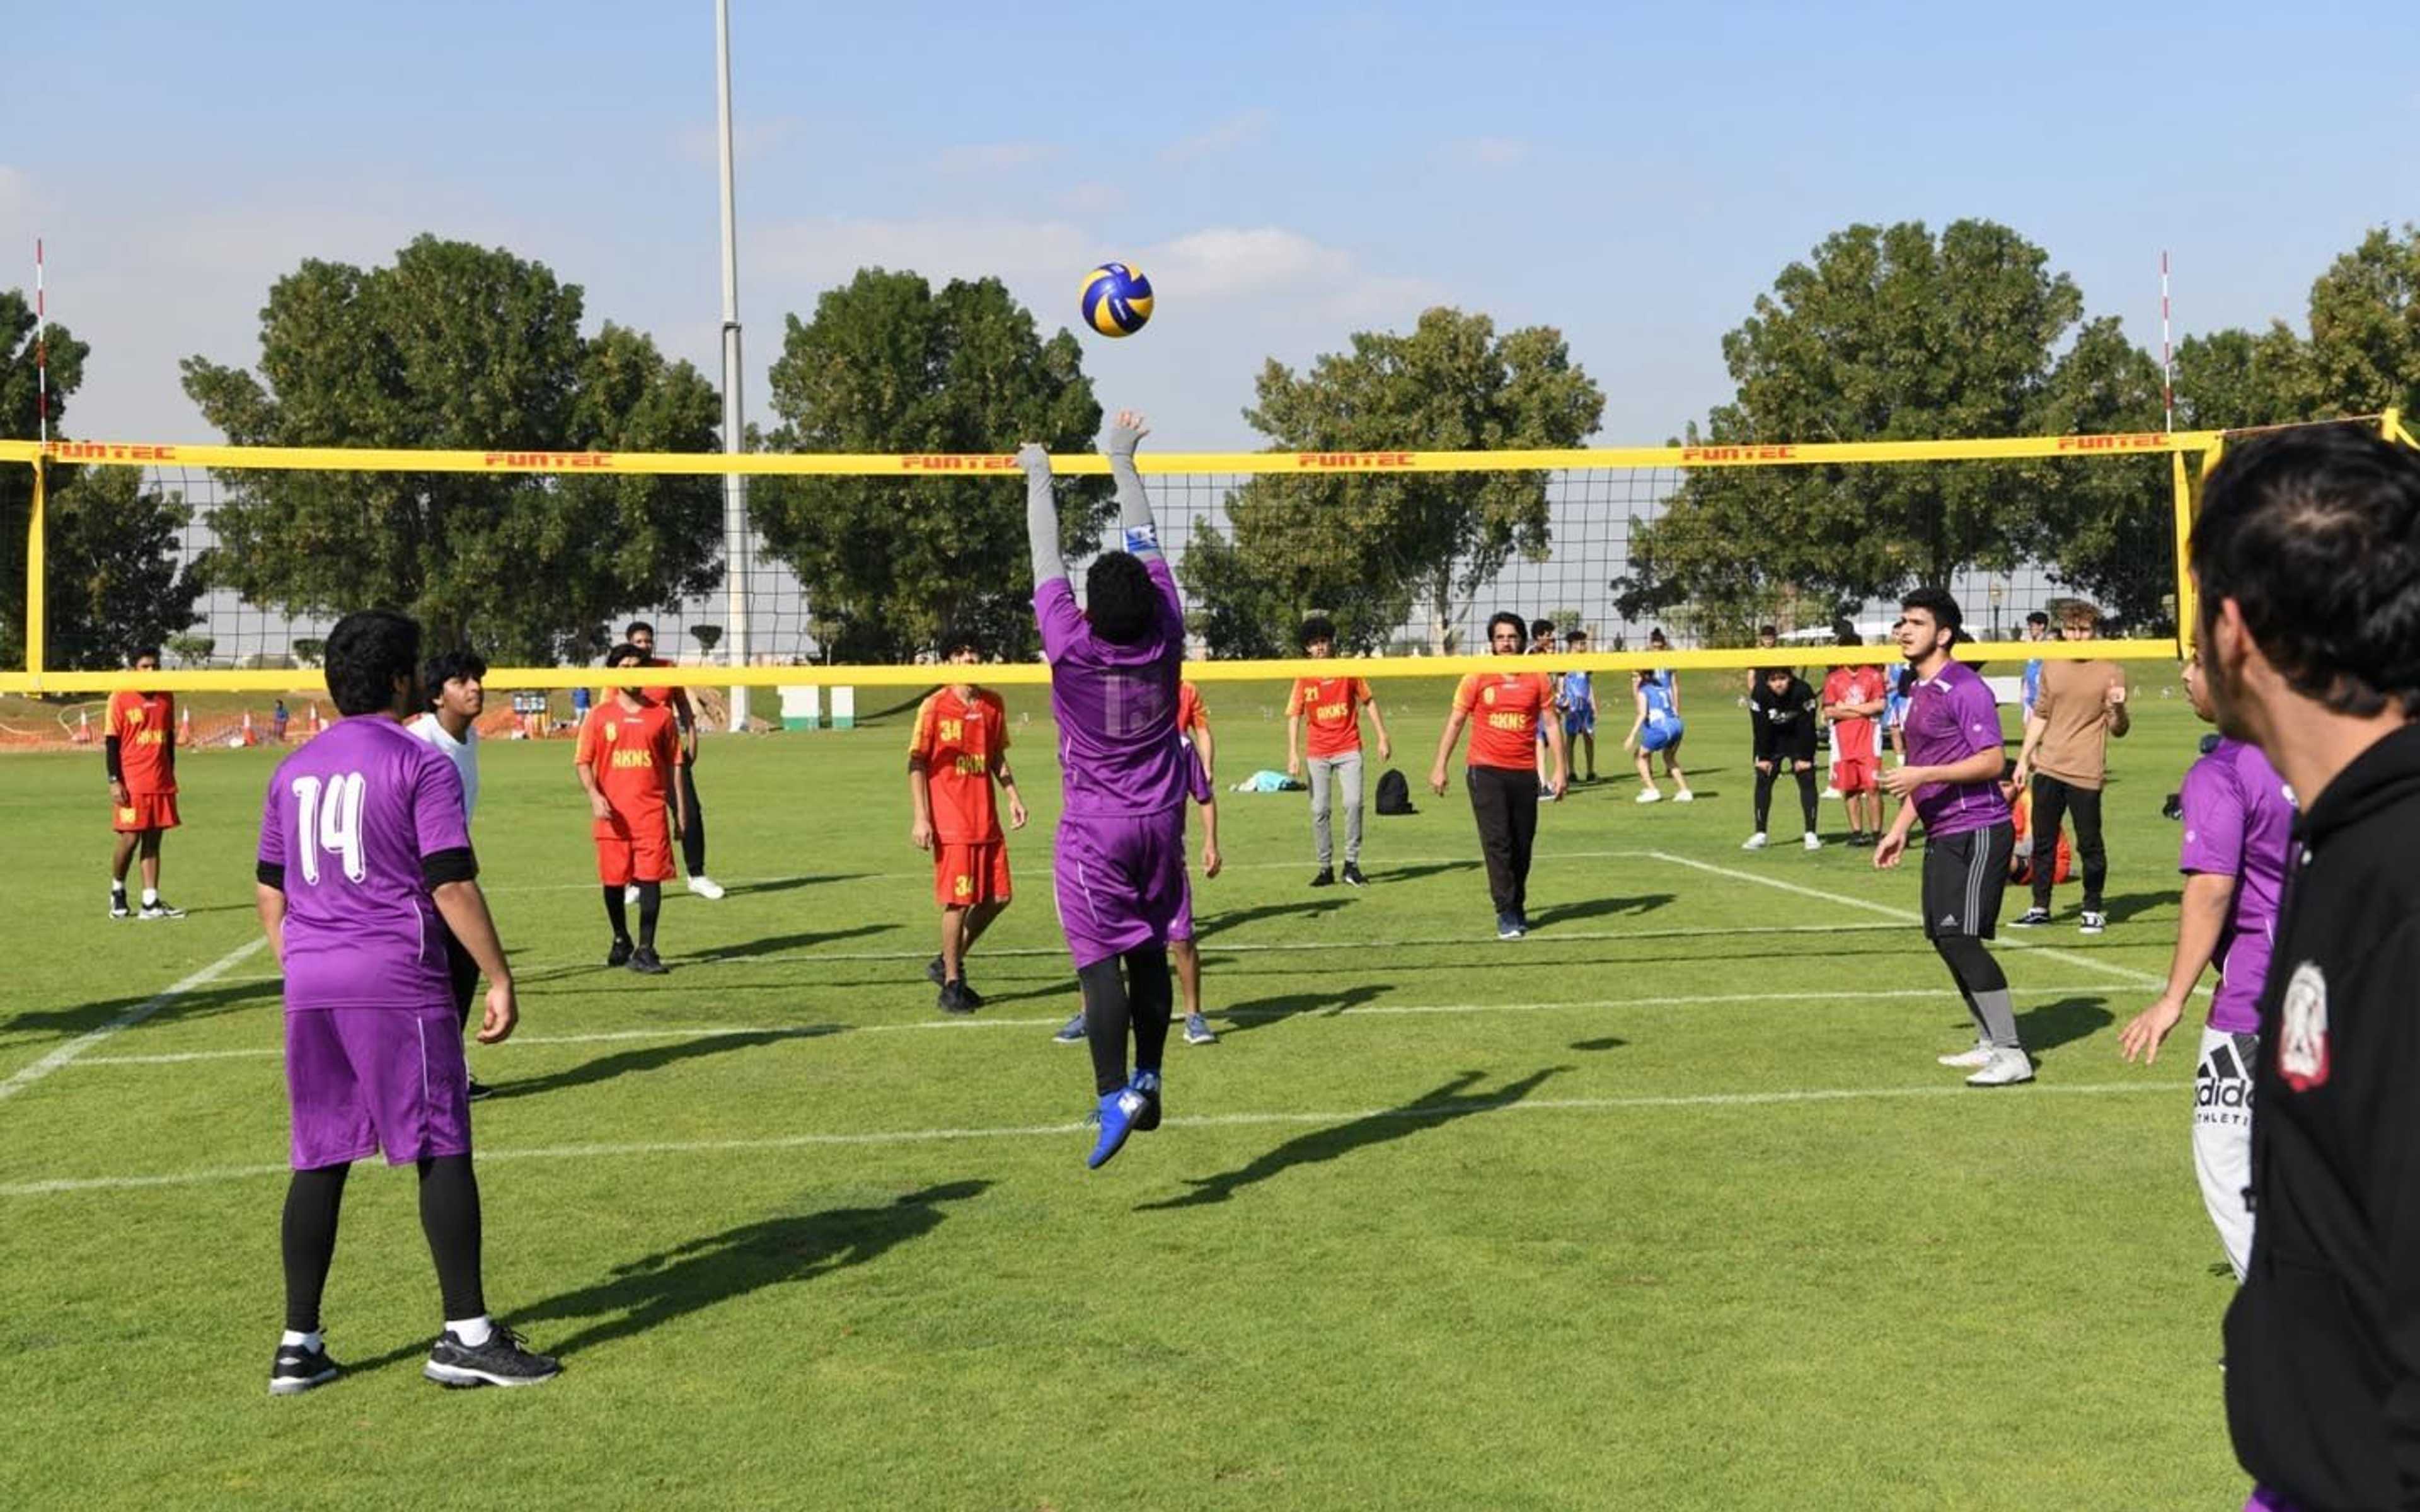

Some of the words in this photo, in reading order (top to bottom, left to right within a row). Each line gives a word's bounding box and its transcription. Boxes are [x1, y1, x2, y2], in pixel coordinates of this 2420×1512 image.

[2058, 433, 2169, 450] FUNTEC
[485, 453, 613, 467] FUNTEC
[1298, 453, 1415, 467] FUNTEC
[1682, 446, 1796, 461] FUNTEC
[940, 720, 962, 742] 34
[955, 753, 986, 776] AKN
[292, 772, 366, 886] 14
[2194, 1077, 2254, 1108] did
